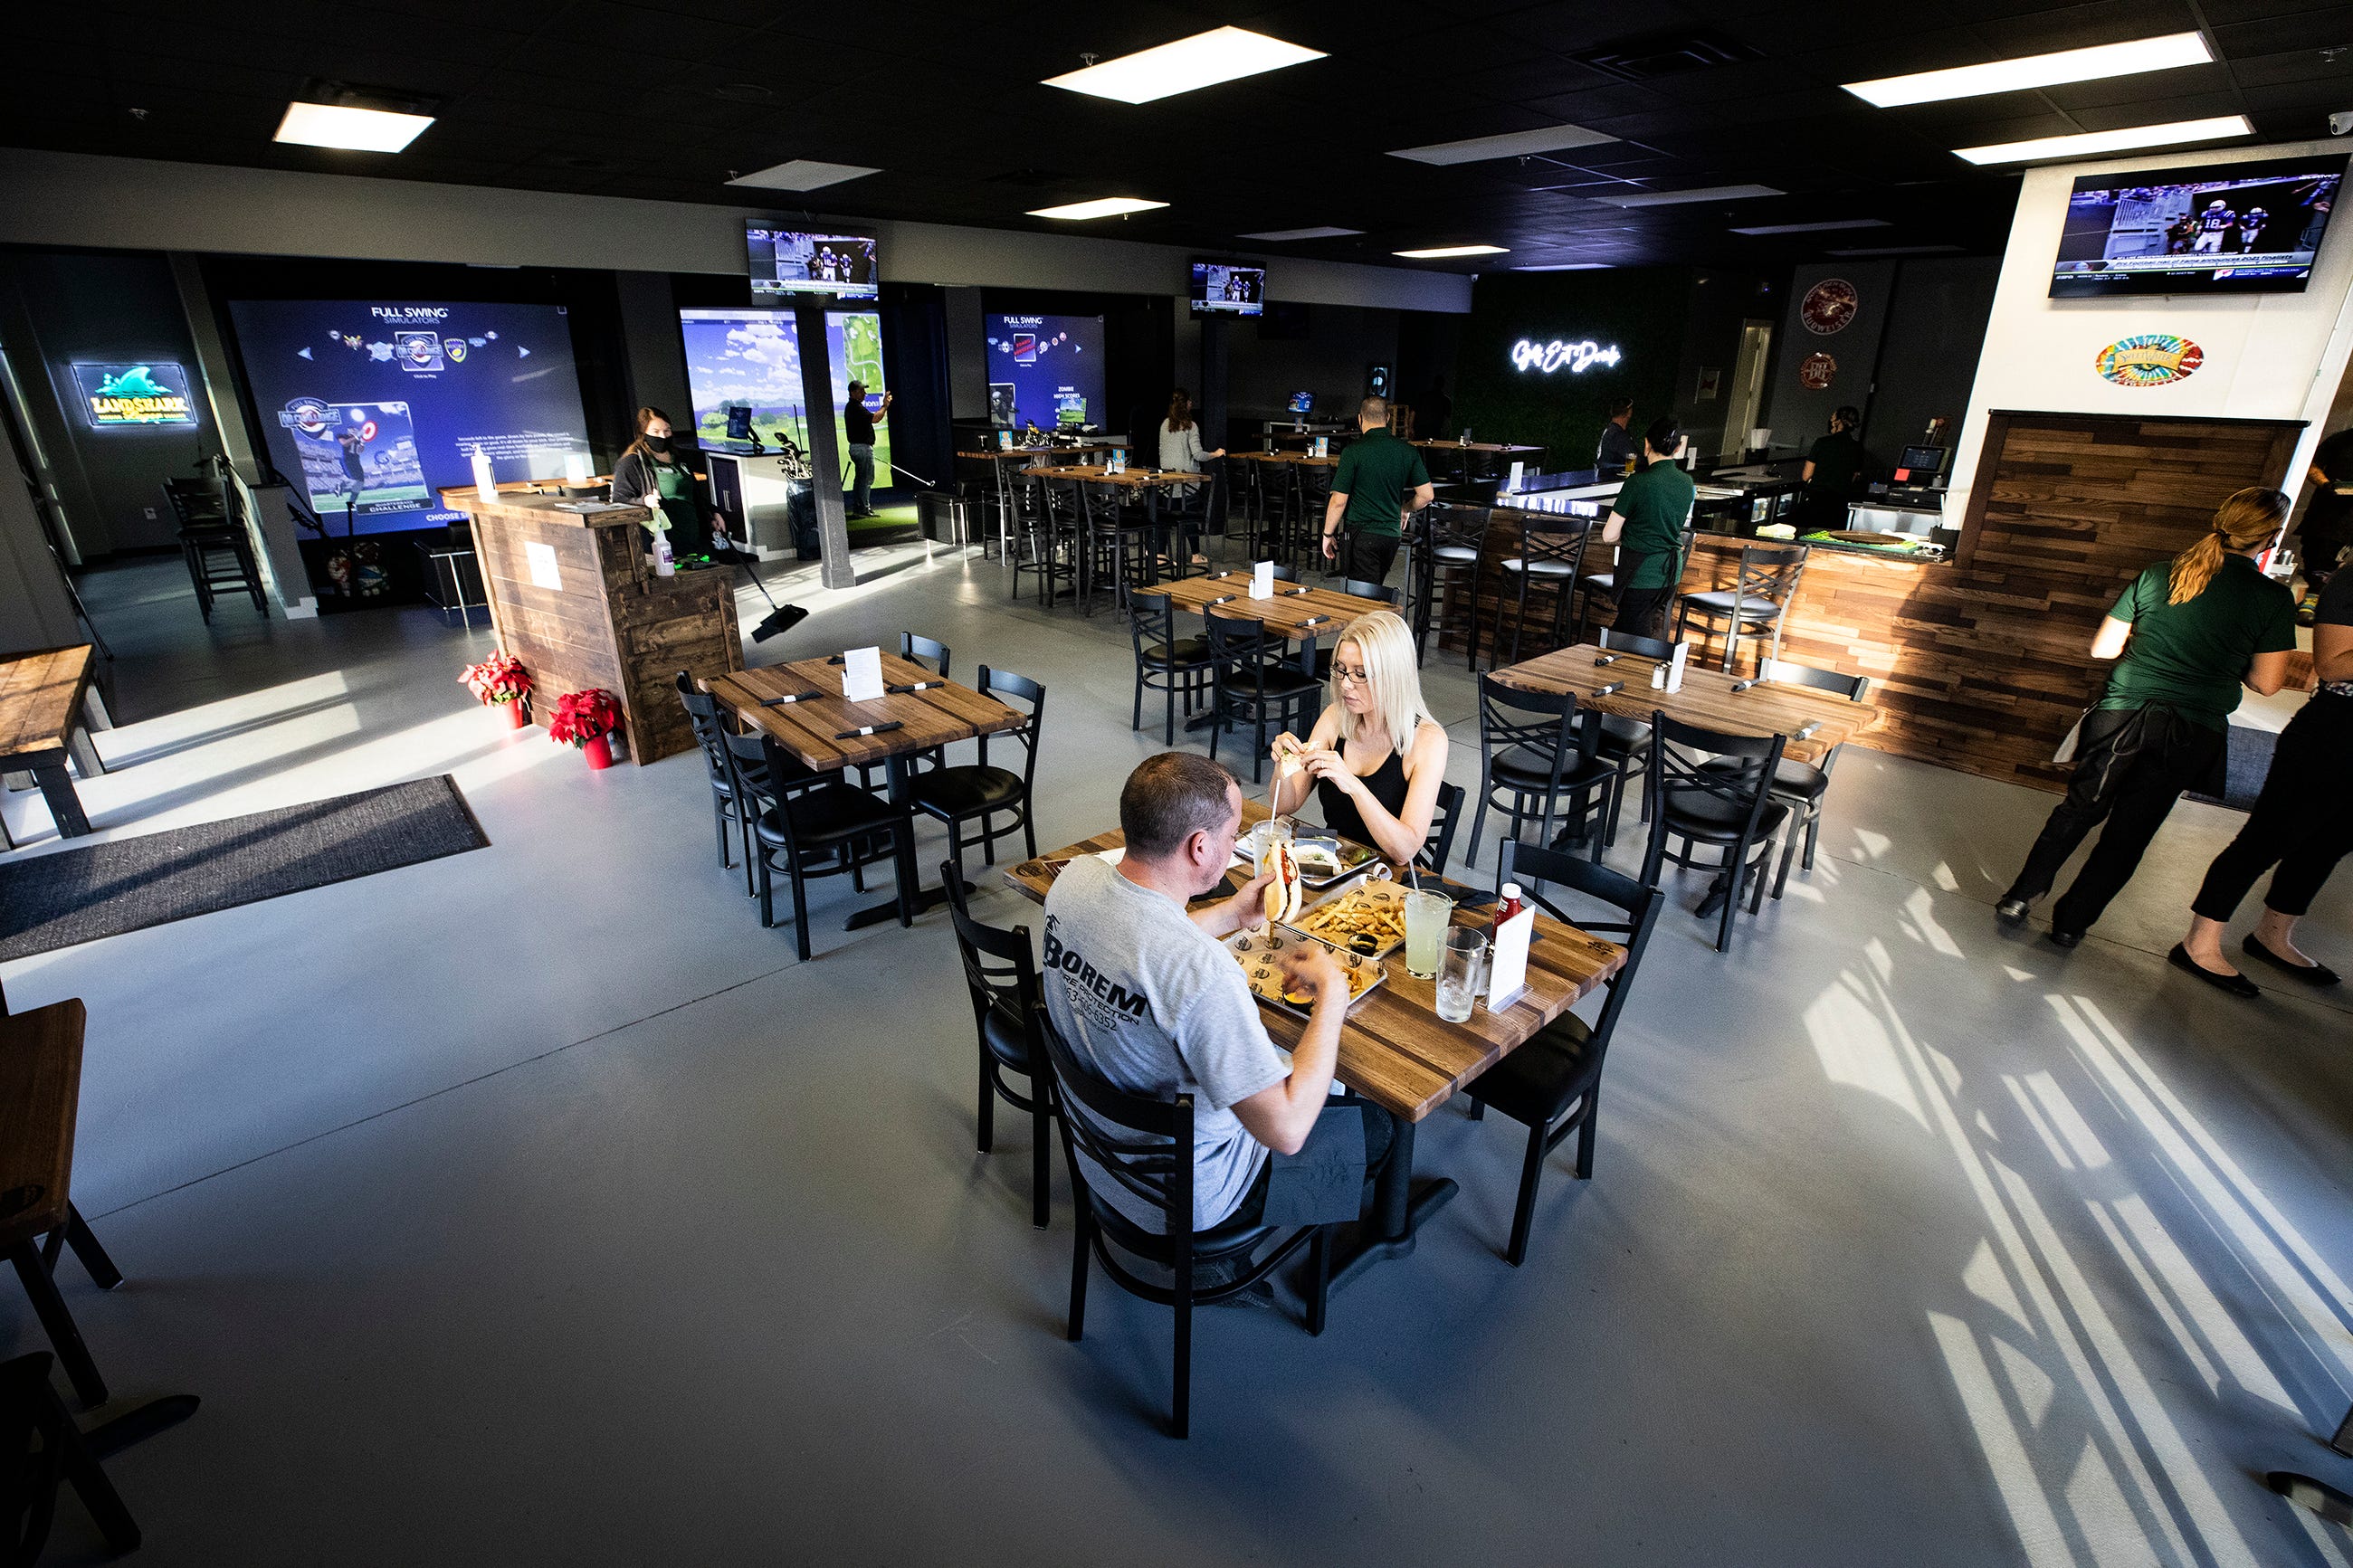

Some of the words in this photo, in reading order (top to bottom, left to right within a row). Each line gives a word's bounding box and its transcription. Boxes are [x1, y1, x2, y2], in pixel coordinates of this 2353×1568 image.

[371, 307, 403, 318] FULL
[405, 308, 448, 318] SWING
[384, 317, 441, 325] SIMULATORS
[1004, 316, 1019, 324] FULL
[1804, 310, 1853, 333] BUDWEISER
[90, 396, 190, 413] LANDSHARK
[368, 503, 422, 513] CHALLENGE
[425, 513, 460, 522] CHOOSE
[1043, 927, 1148, 1017] BOREM
[1079, 984, 1139, 1026] PROTECTION
